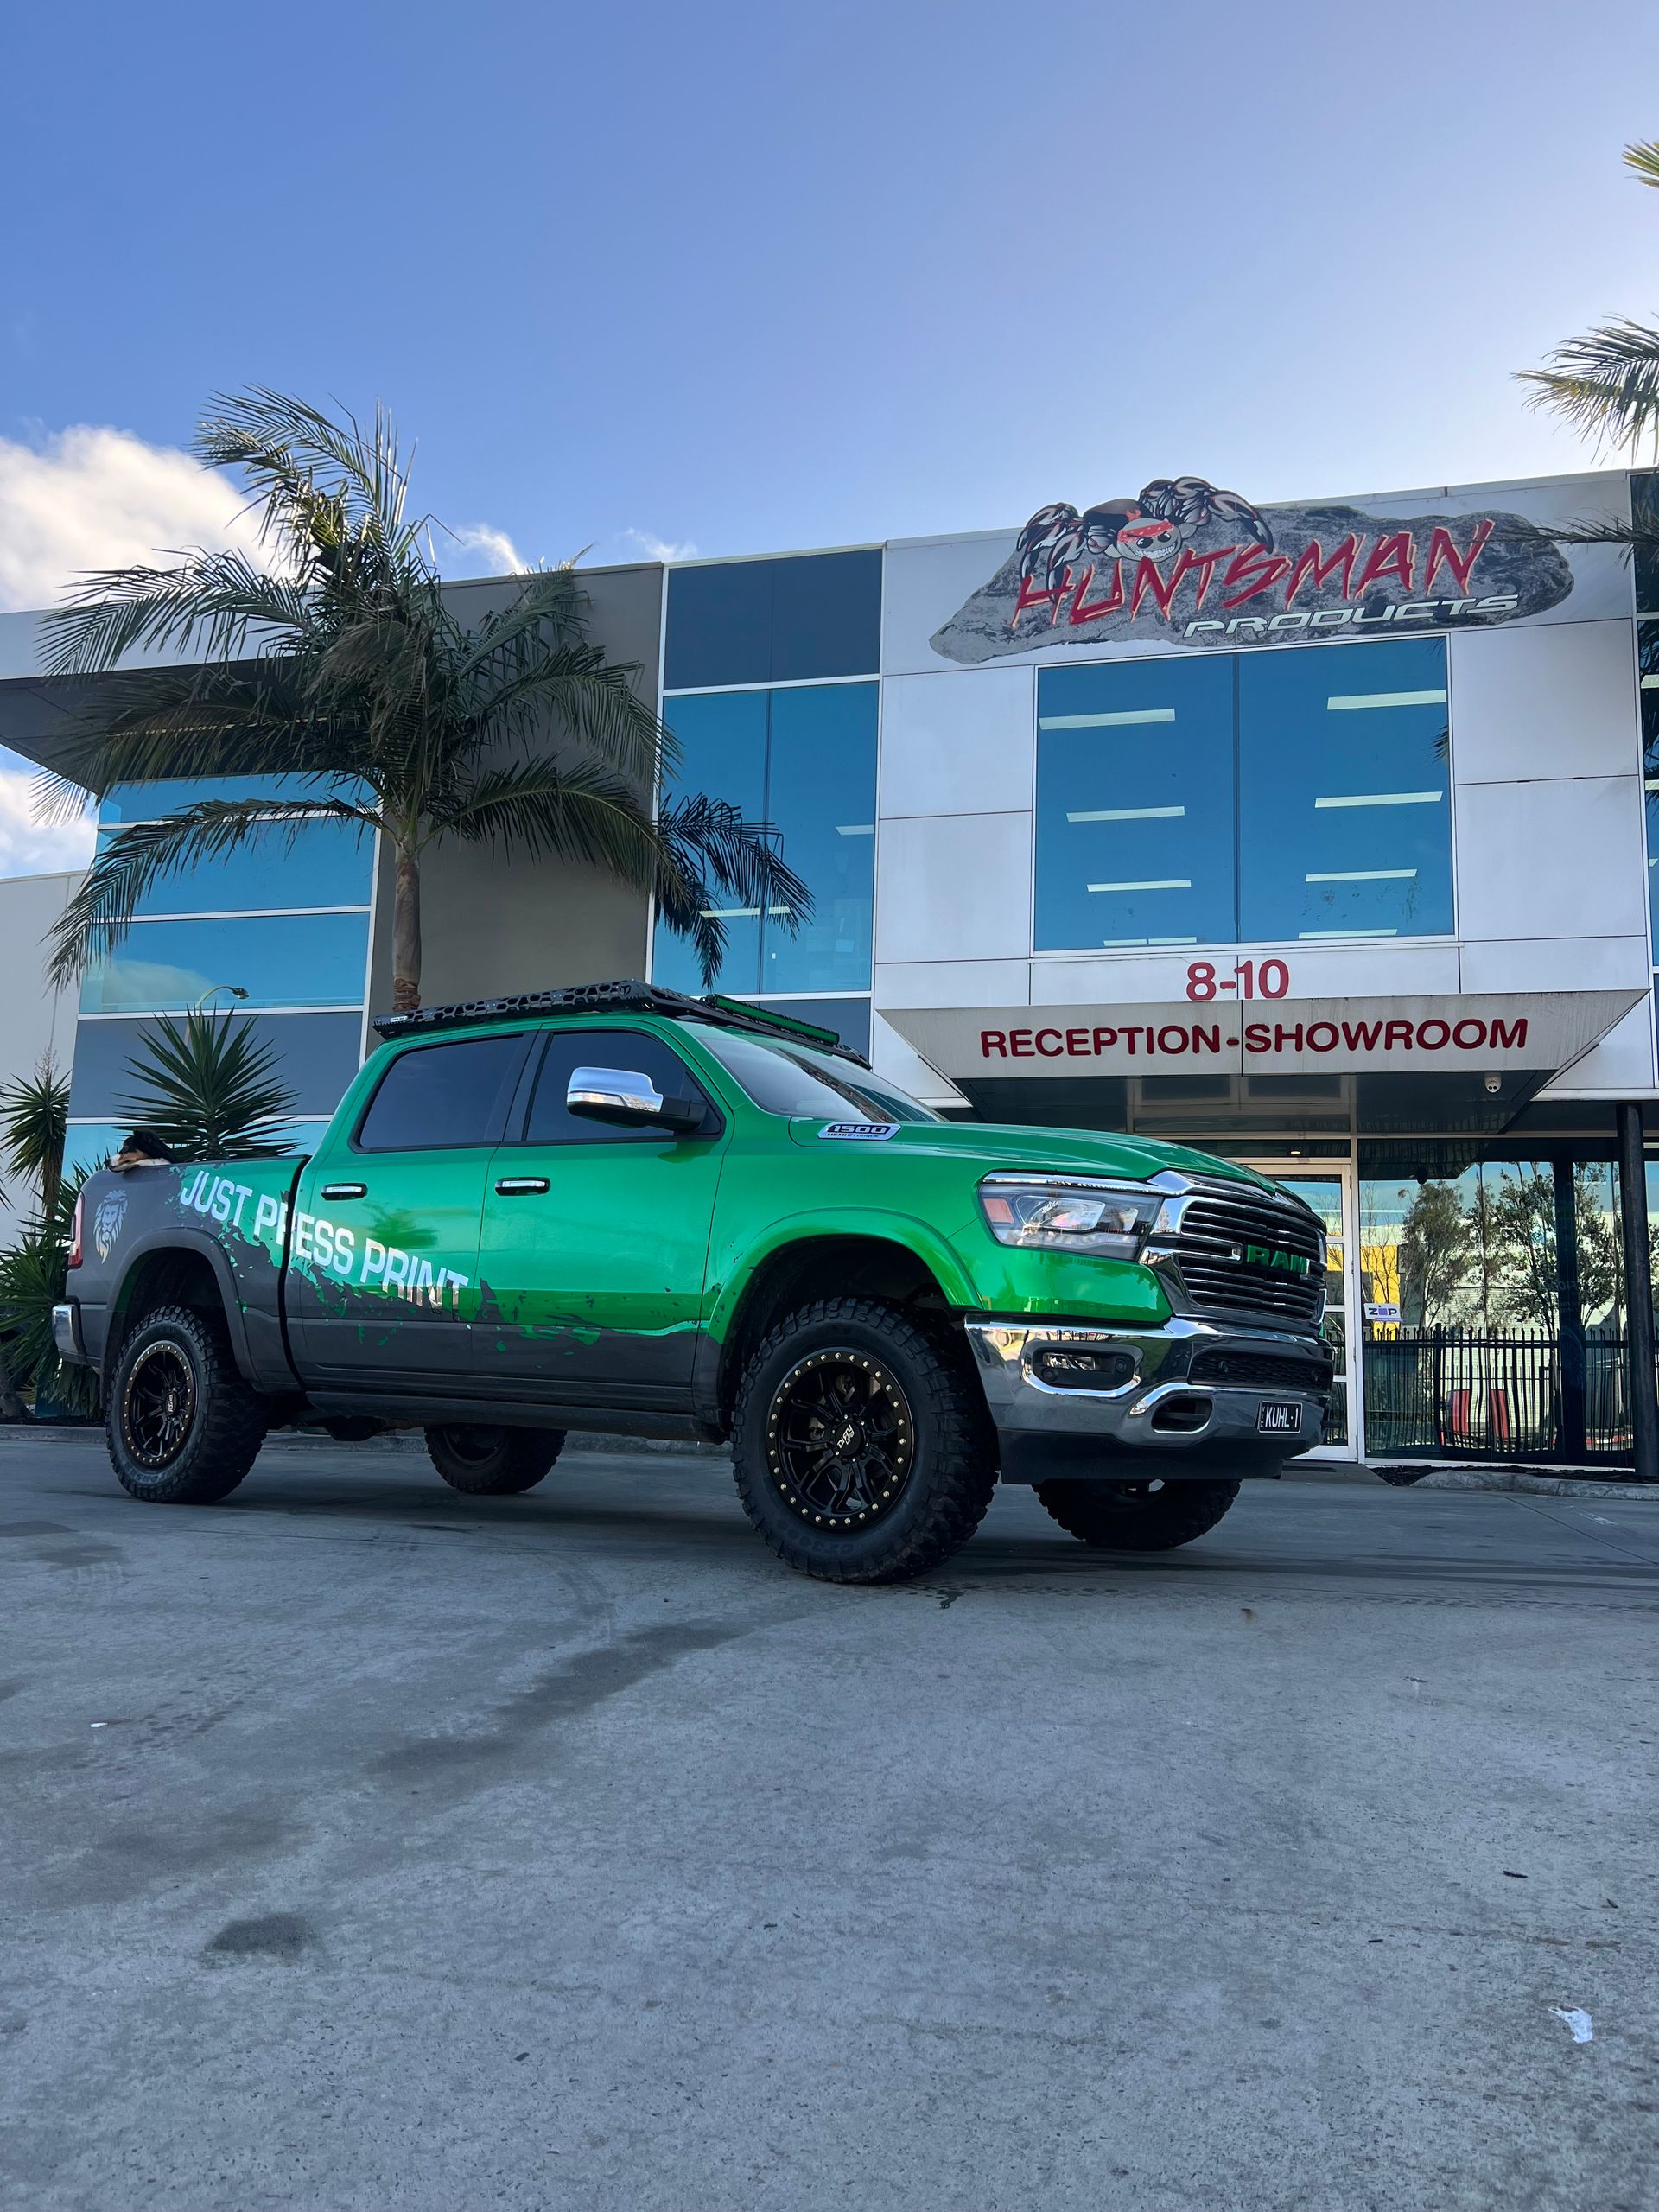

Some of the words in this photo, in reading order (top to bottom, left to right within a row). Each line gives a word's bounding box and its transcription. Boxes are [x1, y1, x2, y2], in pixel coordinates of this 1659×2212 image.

[1010, 518, 1497, 629] HUNTSMAN
[1182, 594, 1518, 638] PRODUCTS
[1186, 959, 1290, 1001] 8-10
[833, 1125, 887, 1134] 1500
[180, 1170, 253, 1227] JUST
[359, 1237, 469, 1307] PRINT
[1247, 1244, 1311, 1274] RAM
